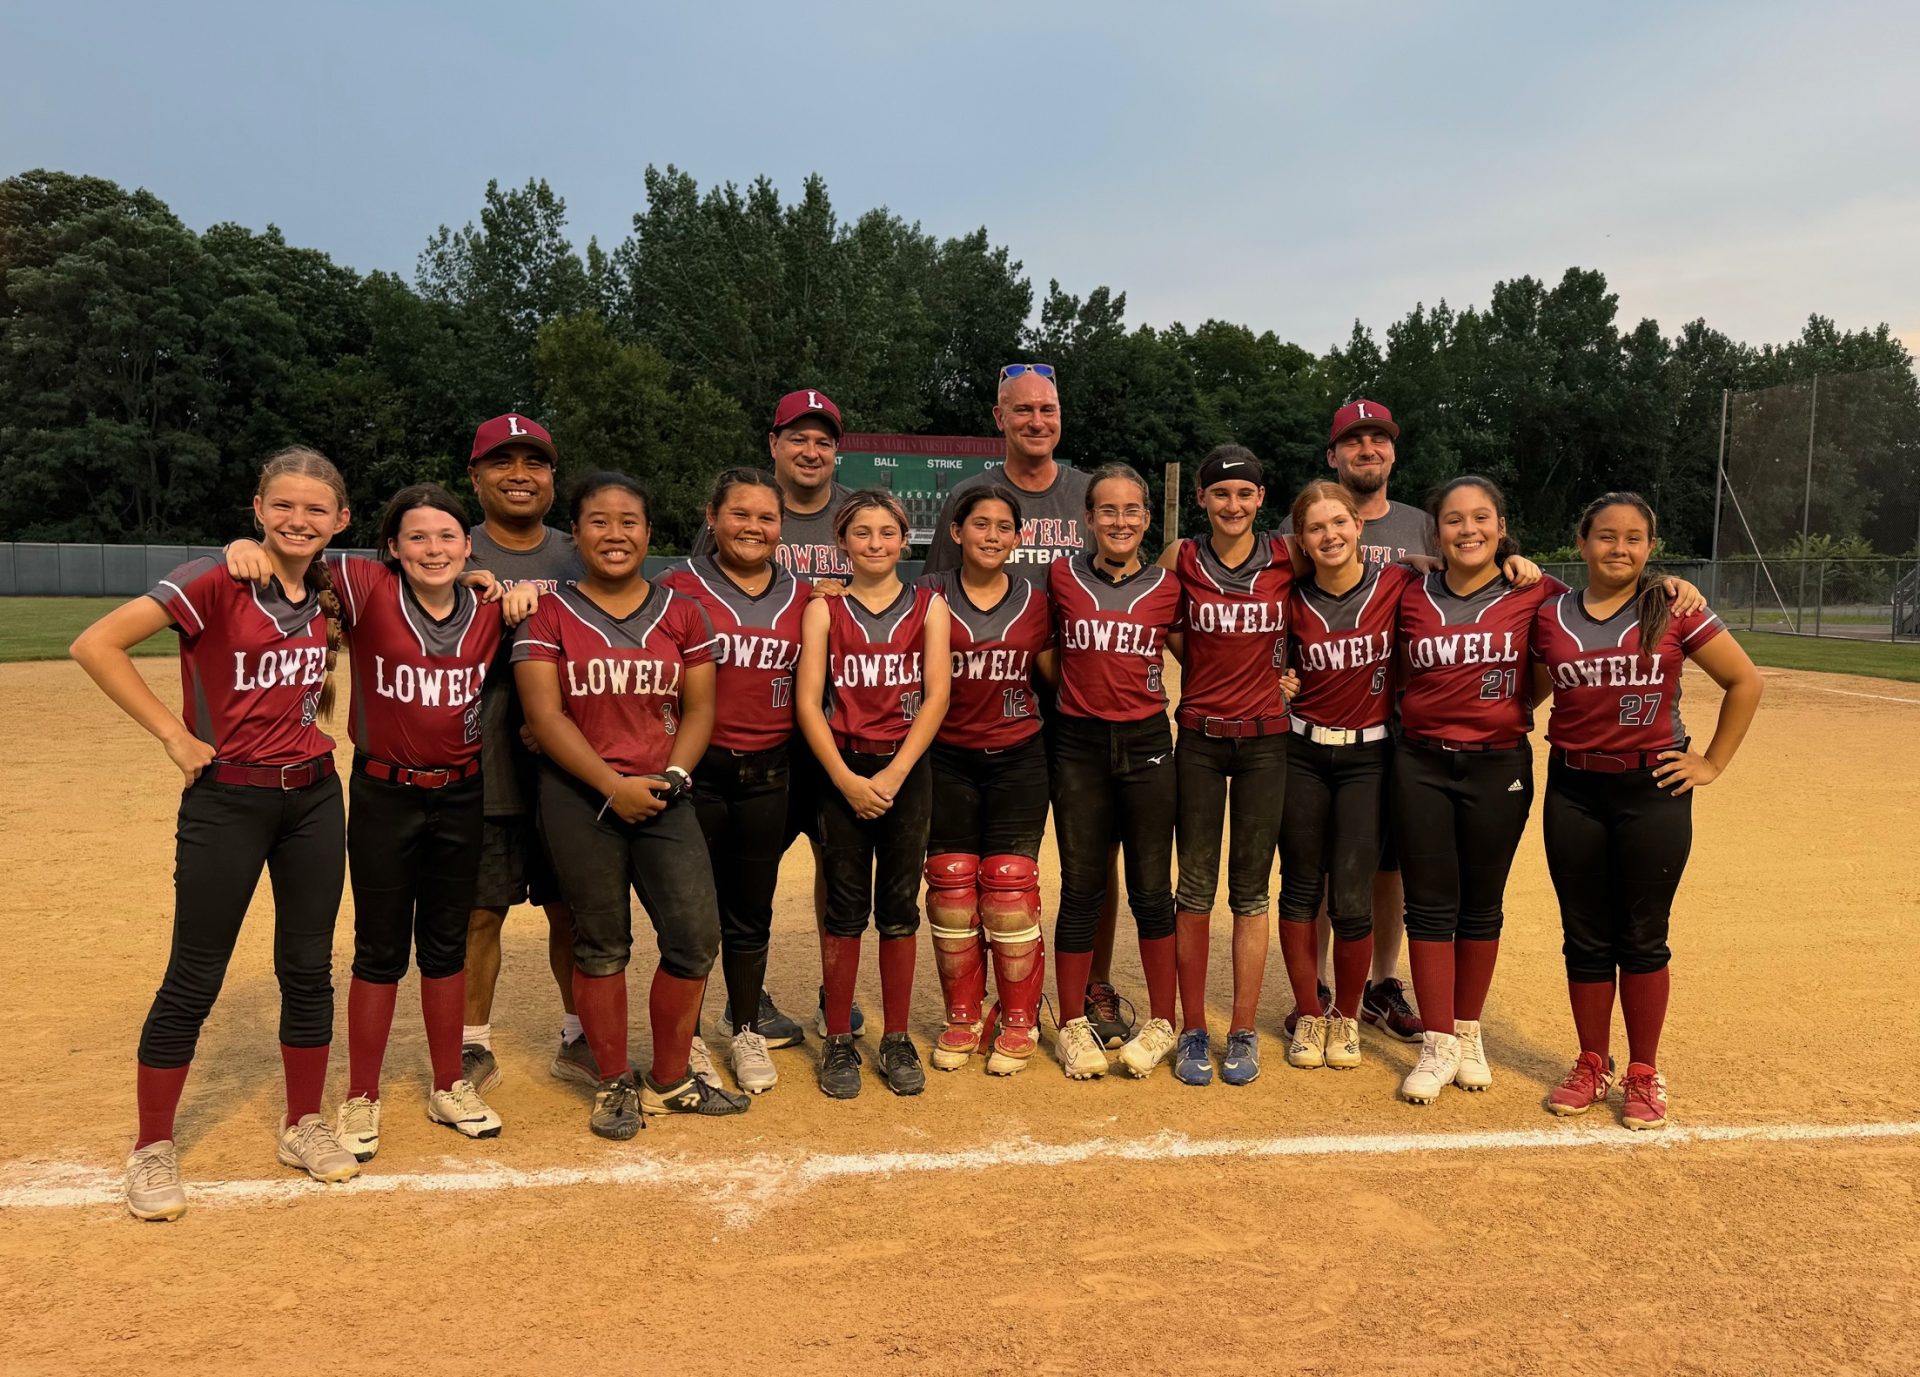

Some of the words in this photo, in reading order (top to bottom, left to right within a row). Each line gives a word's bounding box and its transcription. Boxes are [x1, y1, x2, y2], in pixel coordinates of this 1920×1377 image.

[808, 391, 823, 409] L
[507, 417, 528, 436] L
[874, 457, 899, 467] BALL
[919, 439, 953, 452] VARSITY
[955, 440, 996, 454] SOFTBALL
[927, 459, 963, 469] STRIKE
[1020, 518, 1084, 548] WELL
[1188, 600, 1285, 633] LOWELL
[715, 632, 802, 671] OWELL
[1065, 619, 1157, 656] LOWELL
[1298, 630, 1393, 672] LOWELL
[1408, 632, 1519, 669] LOWELL
[233, 646, 327, 691] LOWE
[566, 658, 681, 698] LOWELL
[830, 652, 922, 688] LOWELL
[950, 649, 1030, 681] OWELL
[1370, 666, 1387, 695] 6
[1546, 653, 1665, 690] LOWELL
[771, 676, 793, 708] 17
[1479, 668, 1517, 700] 21
[1003, 687, 1030, 718] 12
[1618, 692, 1663, 726] 27
